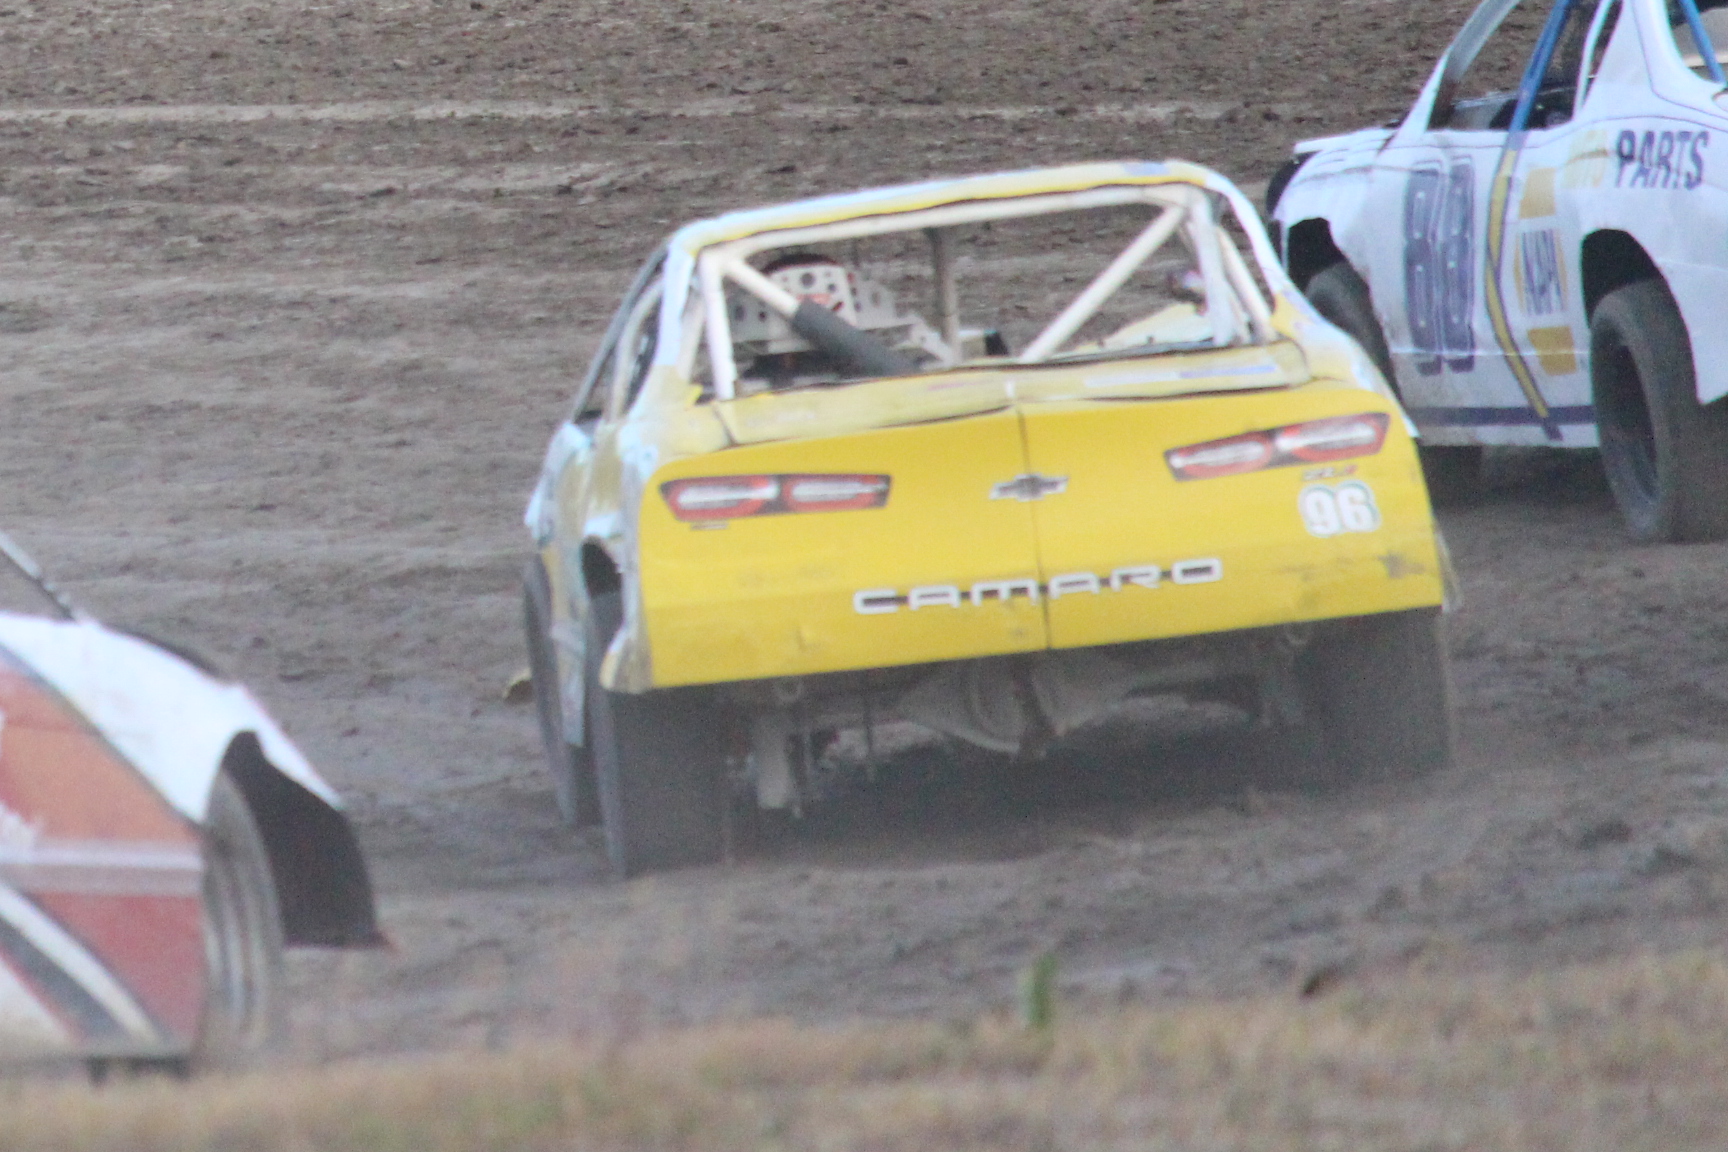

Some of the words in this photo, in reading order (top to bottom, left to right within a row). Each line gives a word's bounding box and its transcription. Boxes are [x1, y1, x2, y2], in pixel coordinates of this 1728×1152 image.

[1615, 129, 1710, 190] PARTS
[1297, 480, 1383, 538] 96
[853, 557, 1223, 615] CAMARO
